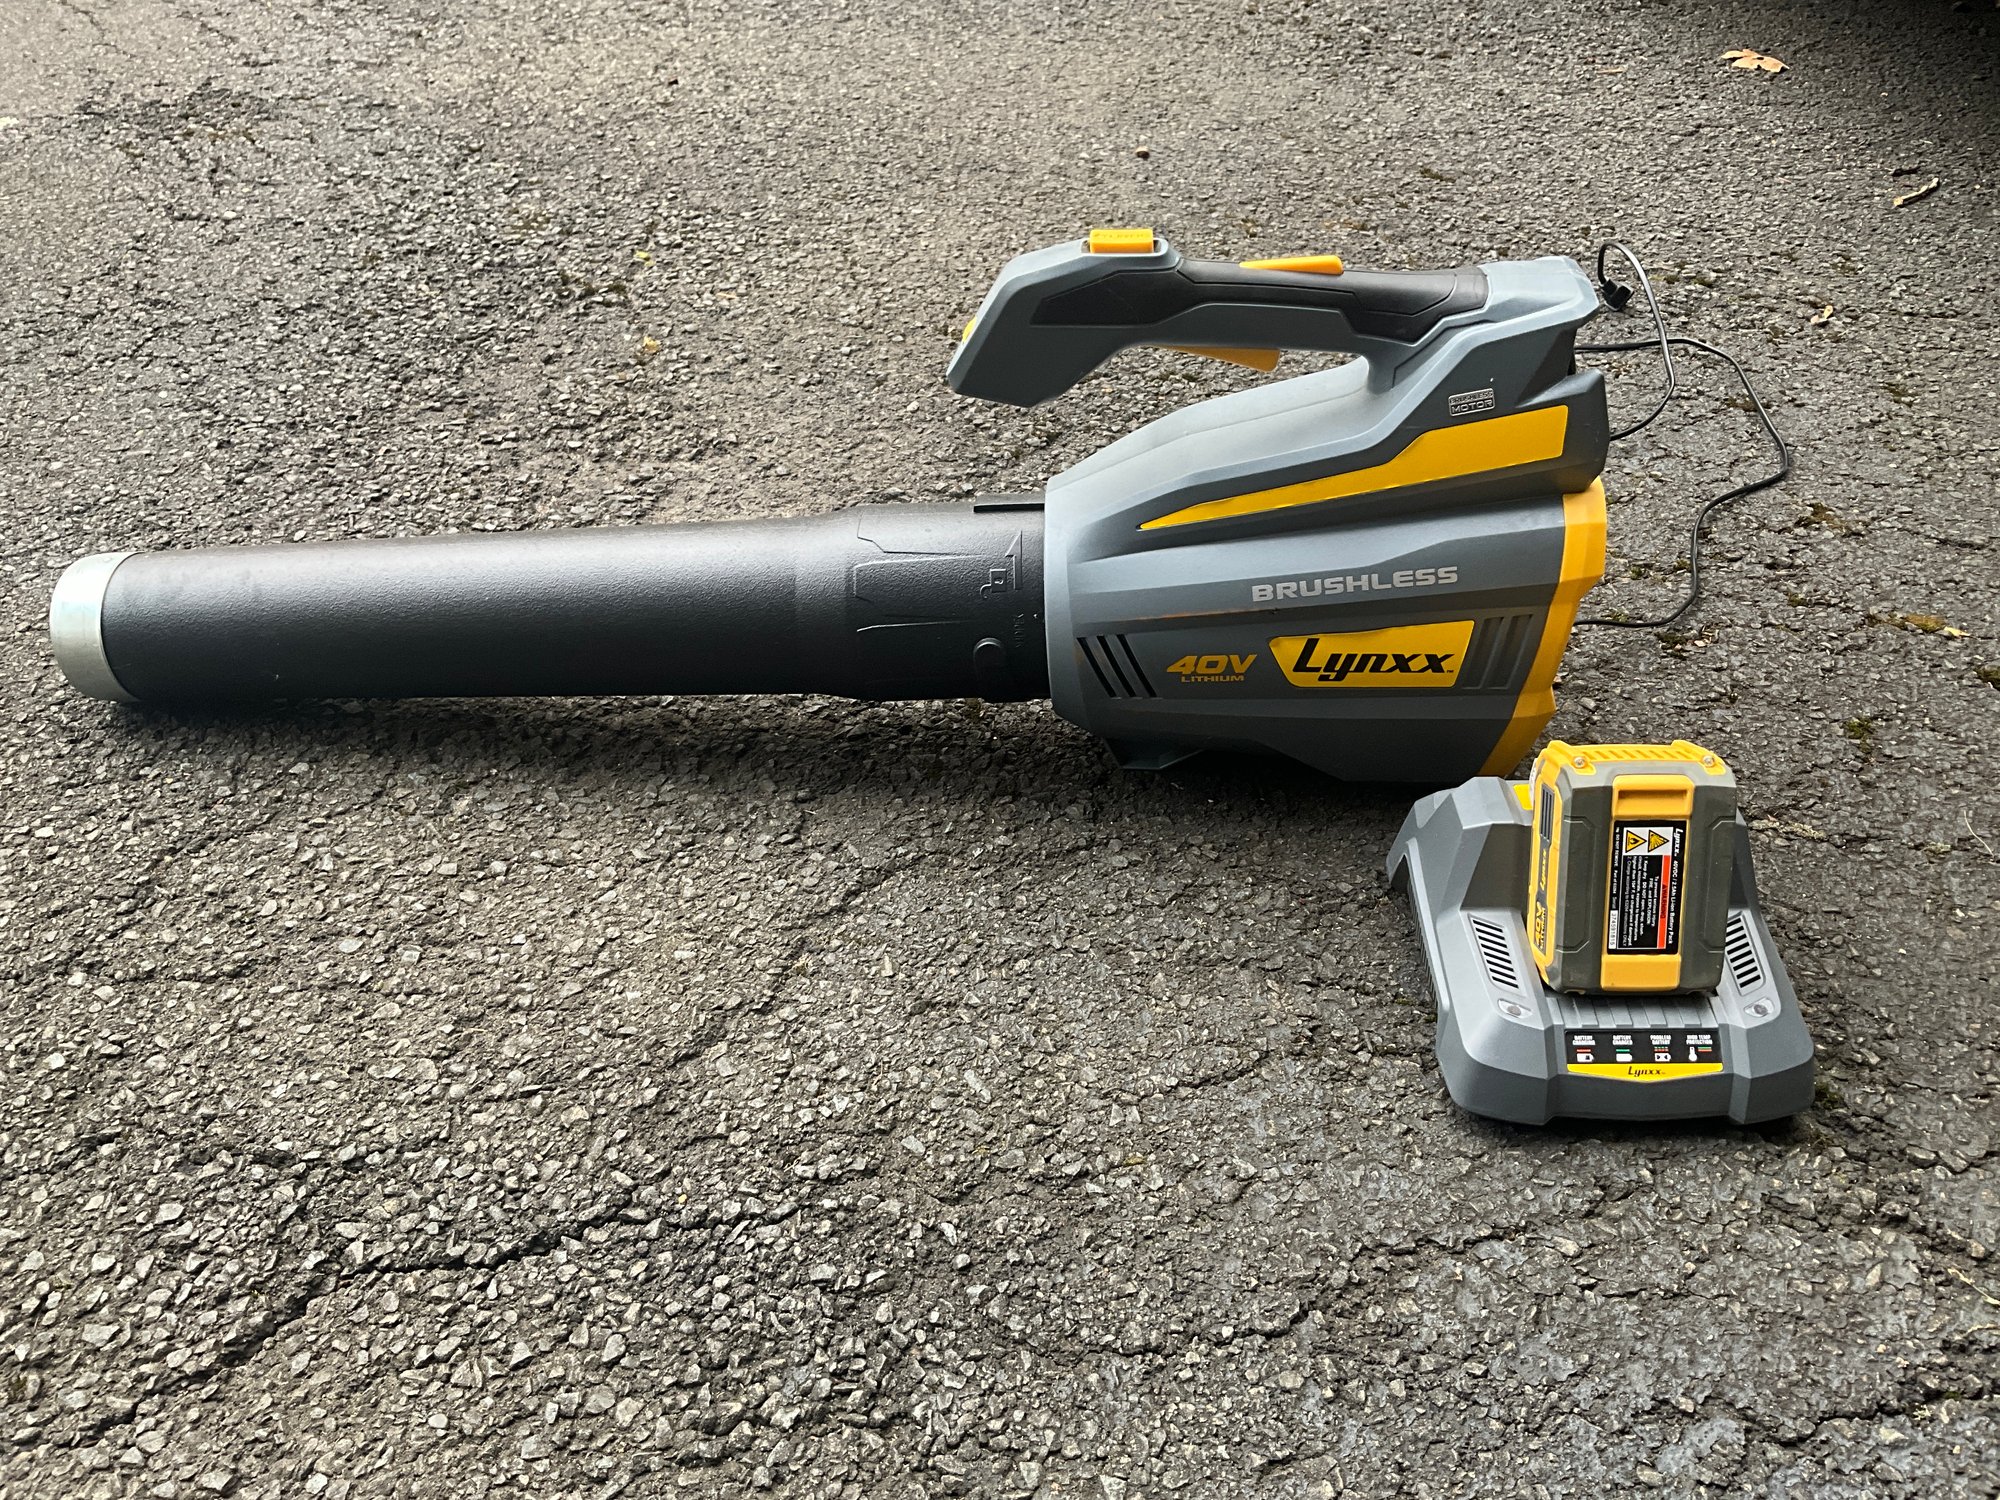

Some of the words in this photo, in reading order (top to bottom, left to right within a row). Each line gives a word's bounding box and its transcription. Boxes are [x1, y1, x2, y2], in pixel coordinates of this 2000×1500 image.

[1452, 400, 1492, 413] MOTOR
[1252, 566, 1458, 602] BRUSHLESS
[1166, 653, 1258, 674] 40V
[1181, 675, 1245, 683] LITHIUM
